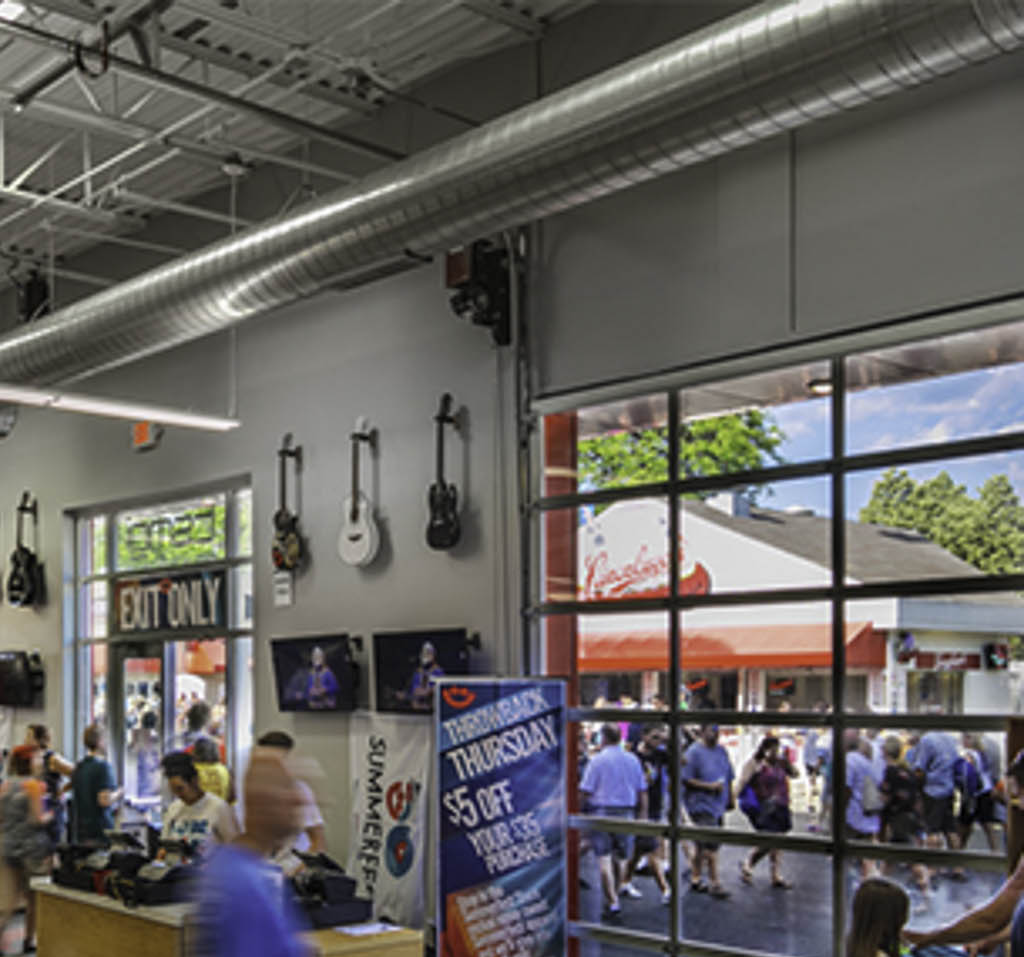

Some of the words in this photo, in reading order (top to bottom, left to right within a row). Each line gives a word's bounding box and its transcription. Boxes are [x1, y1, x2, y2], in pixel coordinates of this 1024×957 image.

[120, 585, 160, 630] EXIT
[167, 577, 221, 627] ONLY
[443, 687, 551, 745] THROWBACK
[446, 714, 558, 781] THURSDAY
[357, 734, 386, 898] SUMMERFE
[443, 785, 478, 827] $5
[476, 779, 514, 820] OFF
[466, 821, 514, 857] YOUR
